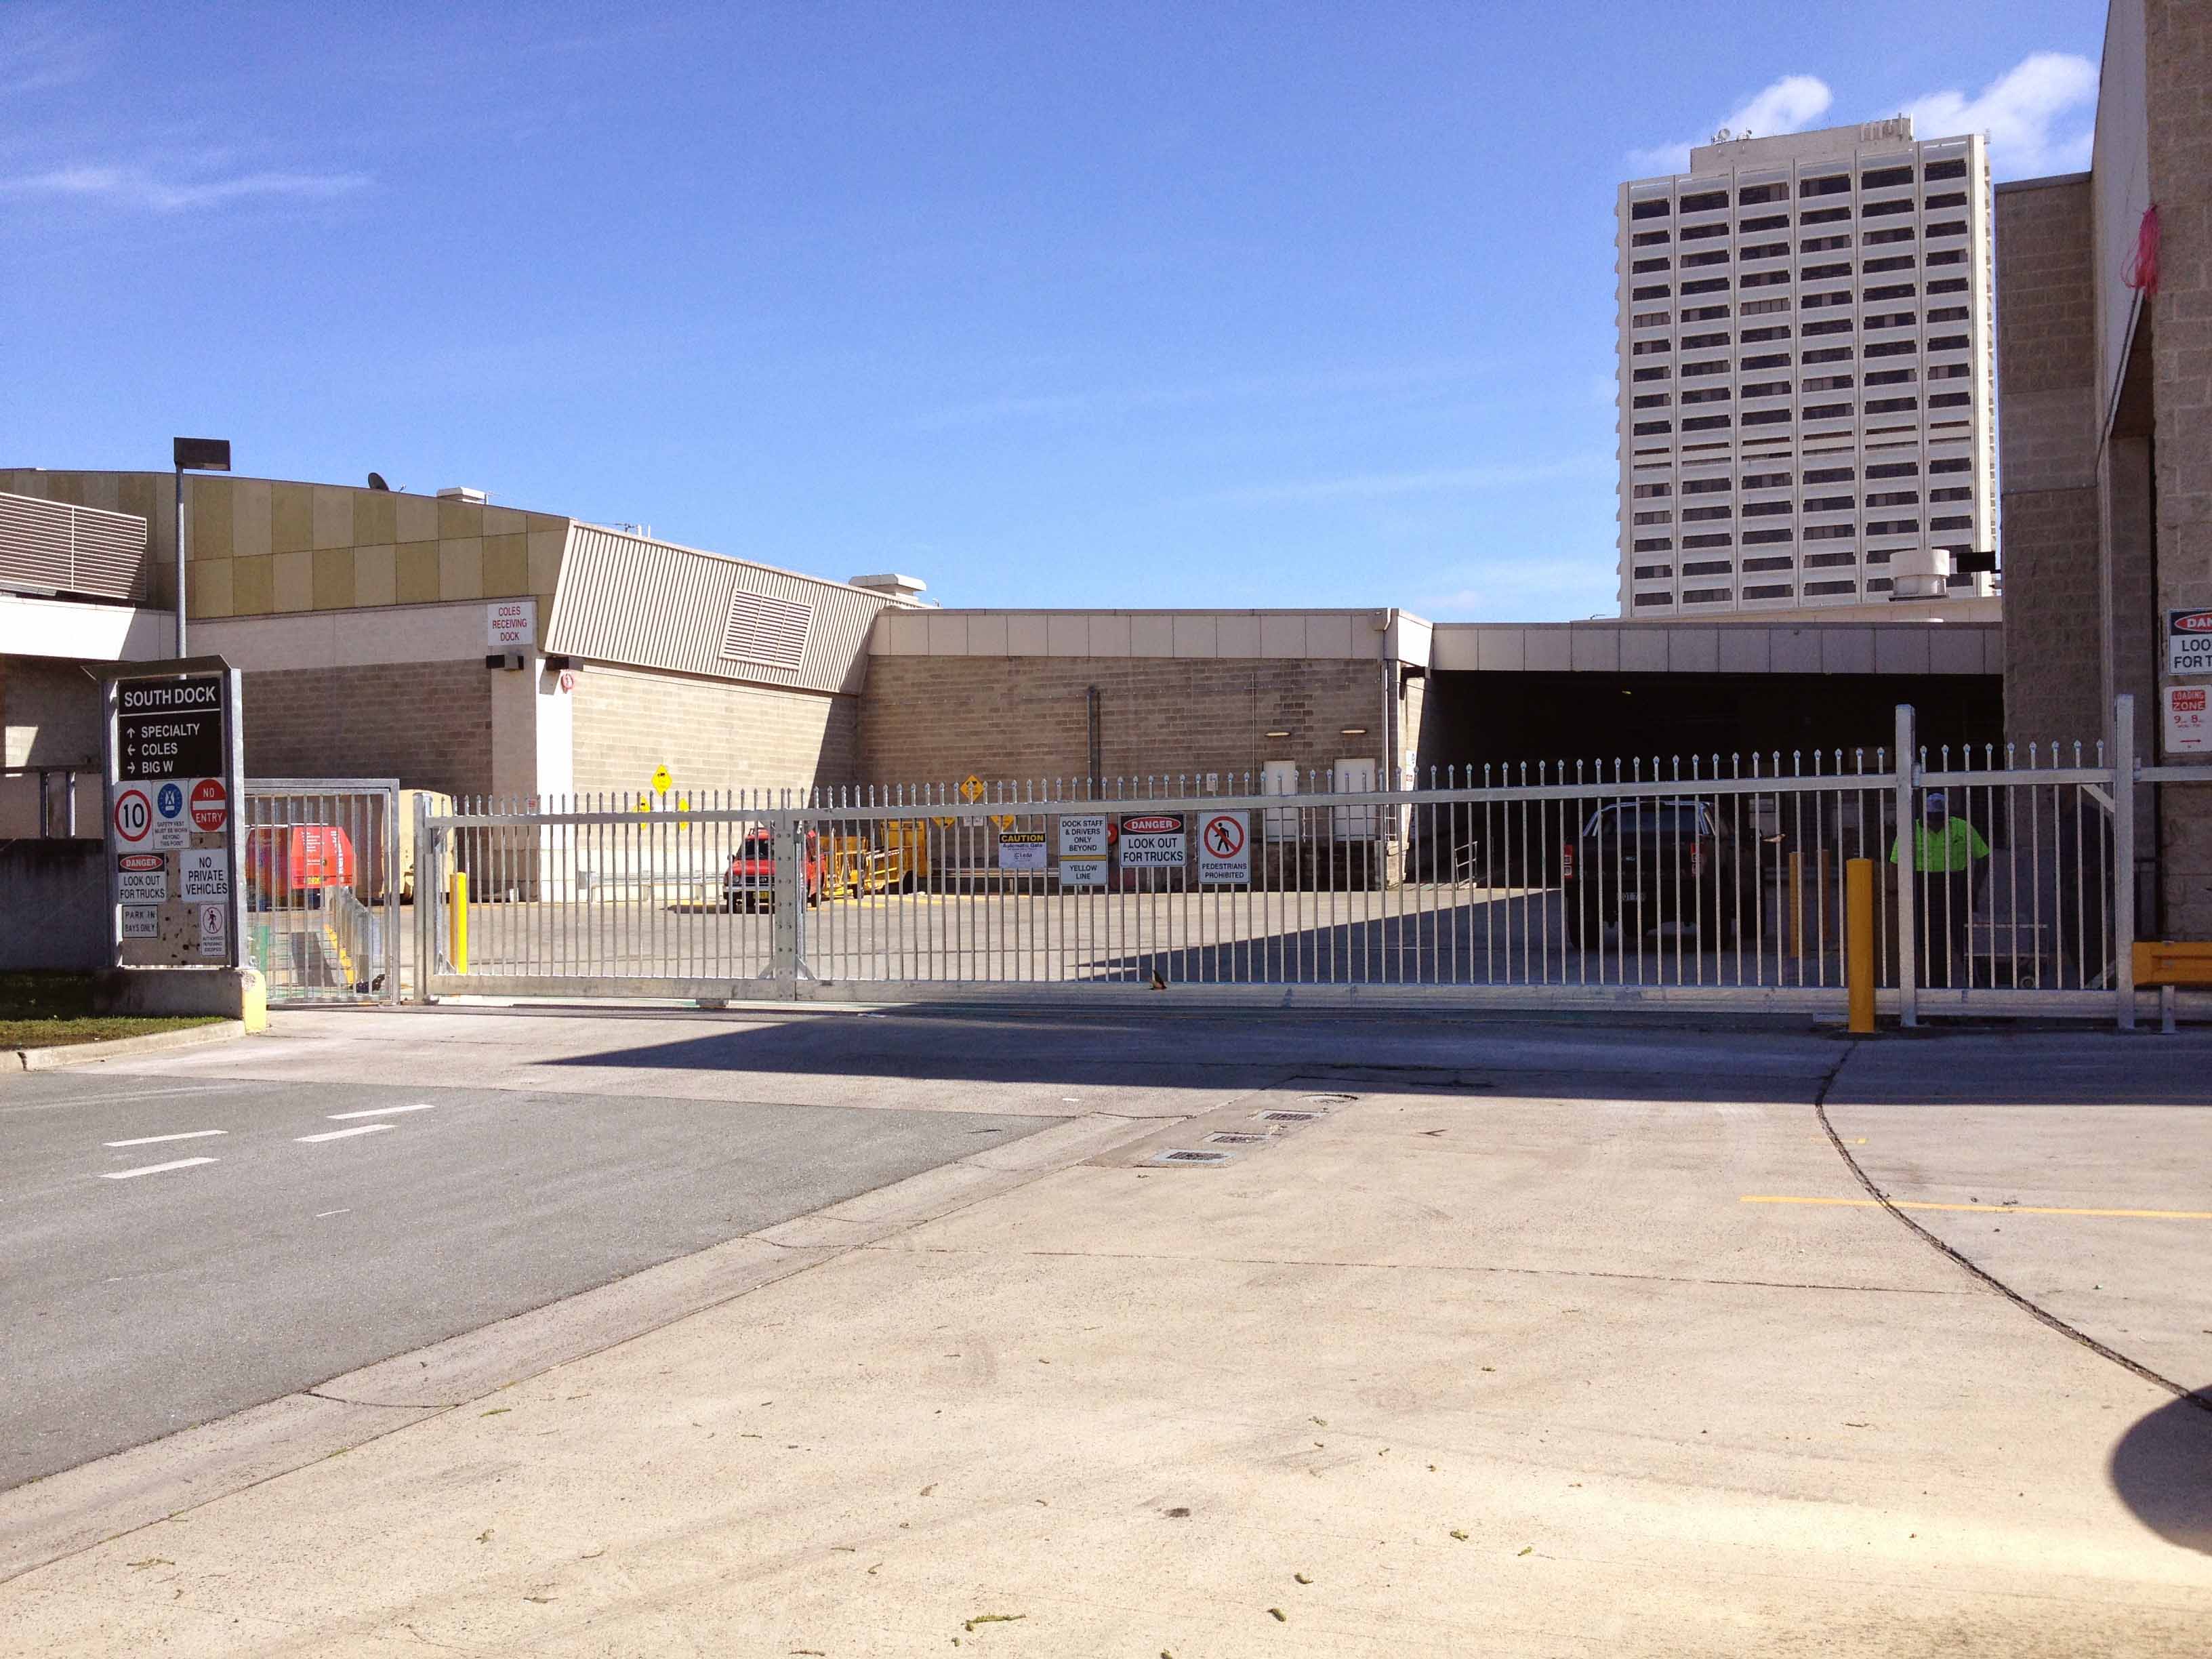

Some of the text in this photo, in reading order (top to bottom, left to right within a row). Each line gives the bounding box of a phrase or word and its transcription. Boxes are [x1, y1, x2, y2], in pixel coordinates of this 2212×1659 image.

[498, 606, 521, 617] COLES
[492, 618, 527, 629] RECEIVING
[500, 632, 520, 641] DOCK
[2174, 655, 2203, 668] FOR
[124, 686, 216, 707] SOUTH DOCK
[2174, 701, 2205, 710] ZONE
[141, 723, 200, 738] SPECIALTY
[141, 743, 178, 756] COLES
[142, 760, 173, 774] BIG W
[203, 787, 215, 798] NO
[123, 803, 145, 828] 10
[196, 813, 222, 823] ENTRY
[1131, 820, 1172, 830] DANGER
[1001, 834, 1044, 842] CAUTION
[1128, 838, 1177, 848] LOOK OUT
[199, 857, 212, 867] NO
[1123, 851, 1183, 862] FOR TRUCKS
[125, 859, 157, 867] DANGER
[123, 875, 161, 886] LOOK OUT
[188, 869, 224, 882] PRIVATE
[120, 888, 165, 899] FOR TRUCKS
[186, 882, 228, 895] VEHICLES
[125, 912, 144, 920] PARK
